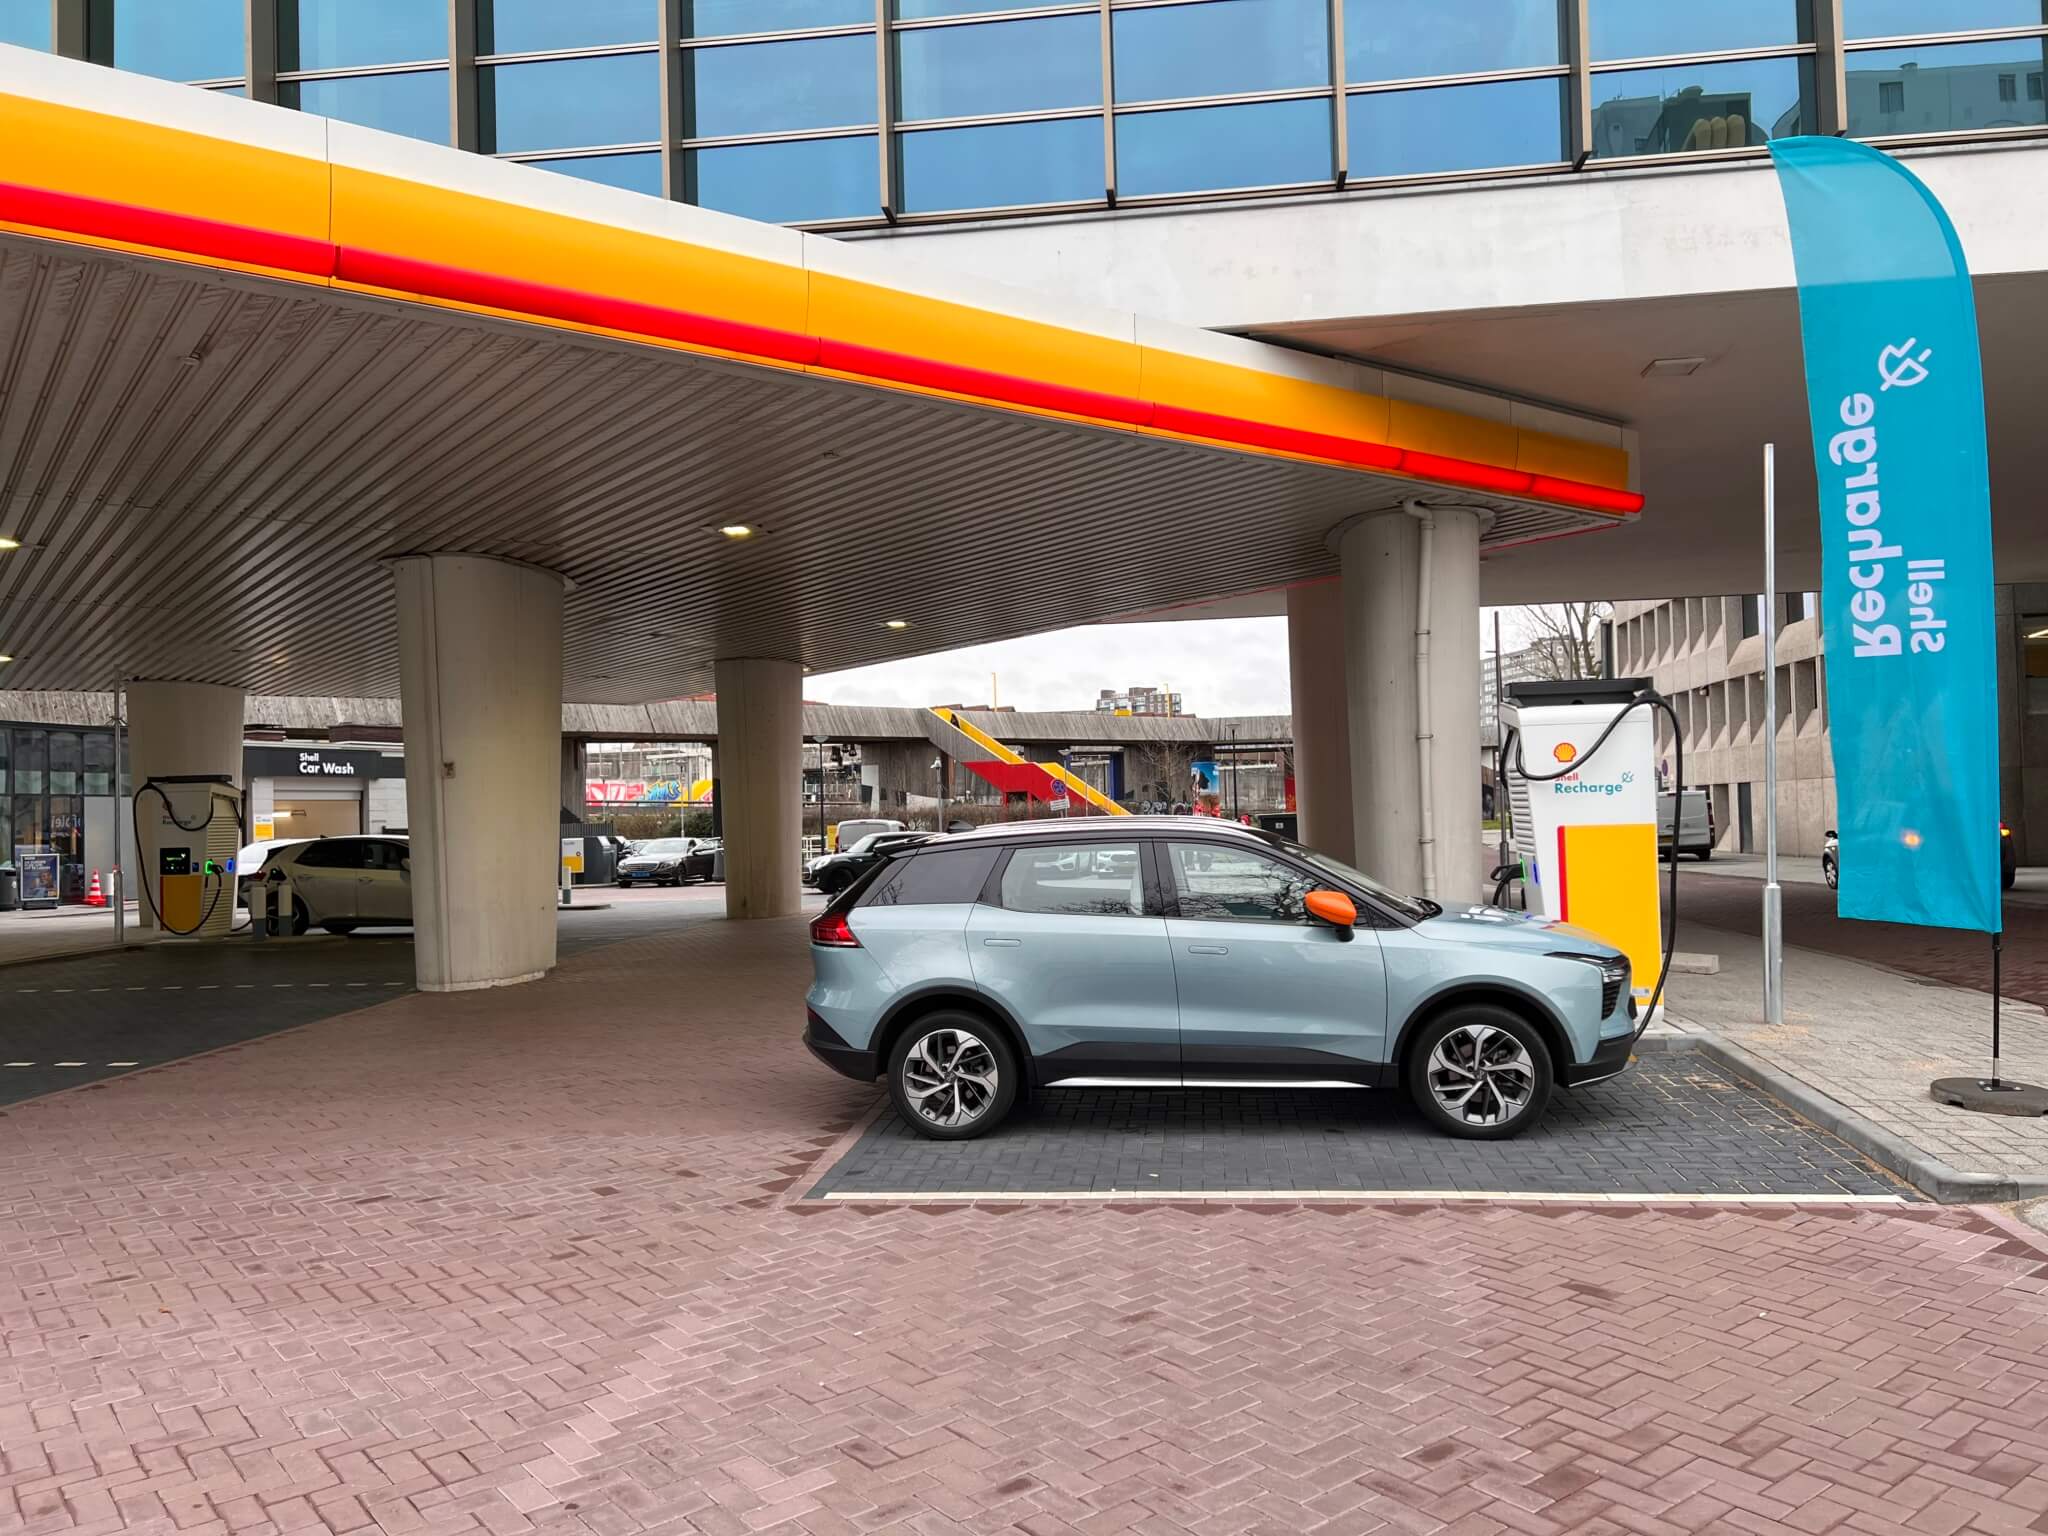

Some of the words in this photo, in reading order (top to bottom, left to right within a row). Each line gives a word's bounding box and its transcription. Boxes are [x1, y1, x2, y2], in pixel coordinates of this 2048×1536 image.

[299, 753, 319, 762] Shell
[299, 762, 321, 774] Car
[323, 762, 354, 774] Wash
[1554, 781, 1623, 795] Recharge
